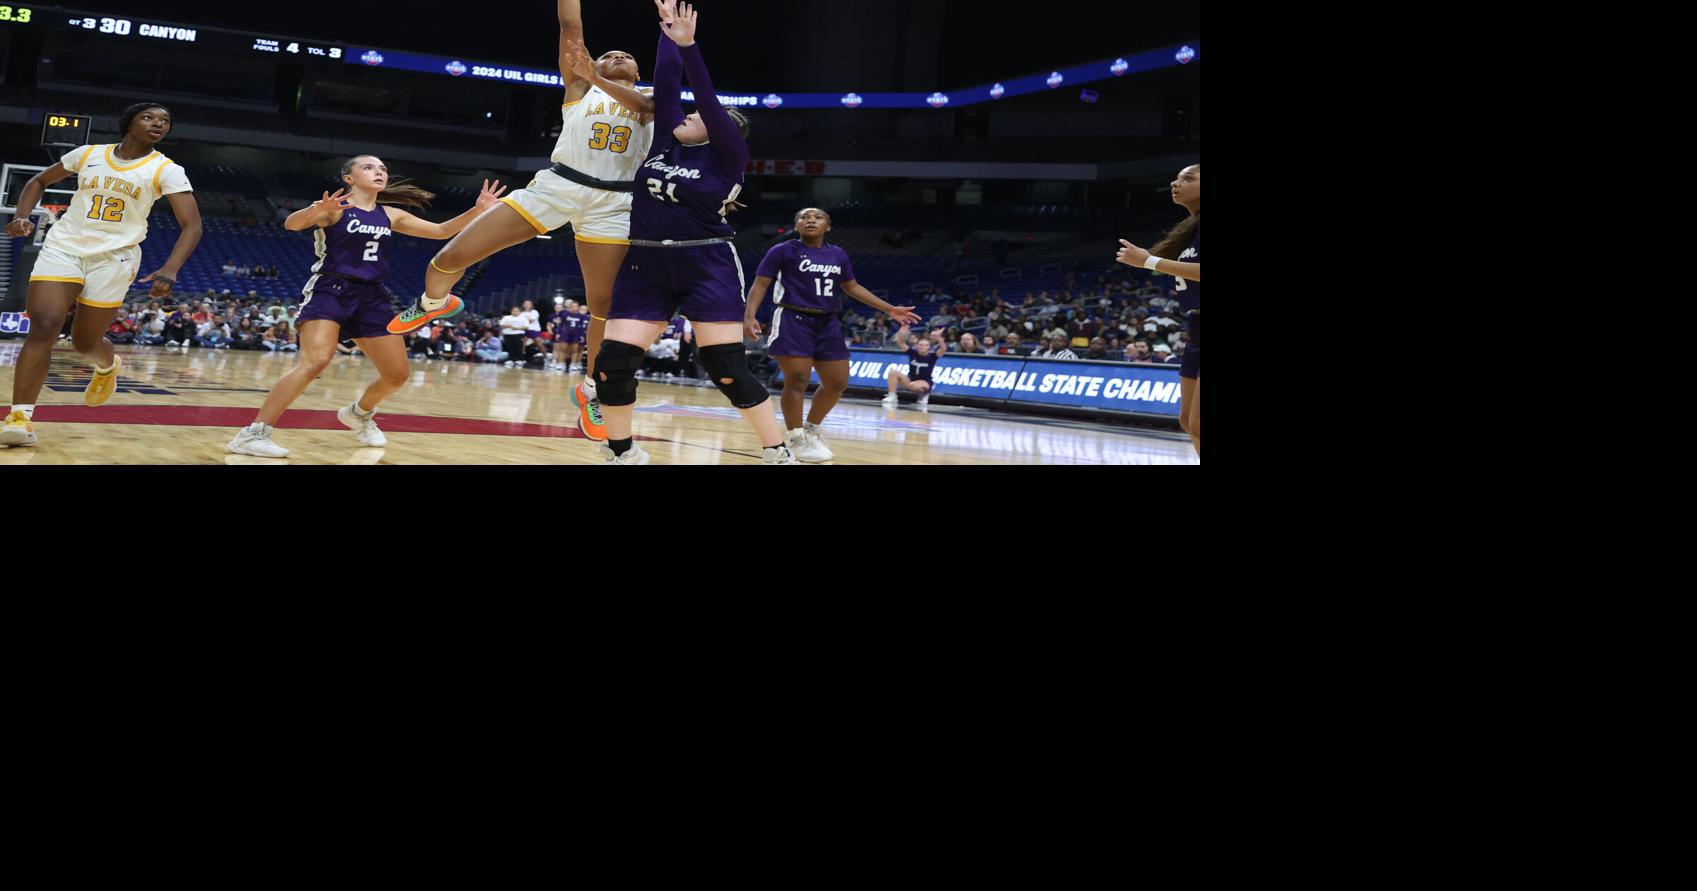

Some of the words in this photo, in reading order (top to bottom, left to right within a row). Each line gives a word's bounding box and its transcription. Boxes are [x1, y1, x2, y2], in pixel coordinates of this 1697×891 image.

[82, 18, 96, 29] 3
[100, 18, 131, 35] 30
[139, 24, 197, 42] CANYON
[253, 44, 280, 52] FOULS
[286, 43, 299, 53] 4
[307, 47, 326, 56] TOL
[329, 47, 342, 58] 3
[472, 66, 502, 78] 2024
[503, 70, 524, 81] UIL
[524, 73, 559, 85] GIRLS
[588, 121, 632, 154] 33
[644, 154, 701, 180] Canyon
[79, 176, 100, 190] LA
[104, 176, 143, 201] VEGA
[87, 194, 126, 223] 12
[346, 219, 392, 240] Canyo
[362, 241, 379, 262] 2
[814, 278, 834, 297] 12
[859, 361, 883, 379] UIL
[931, 365, 1036, 391] BASKETBALL
[1038, 373, 1104, 398] STATE
